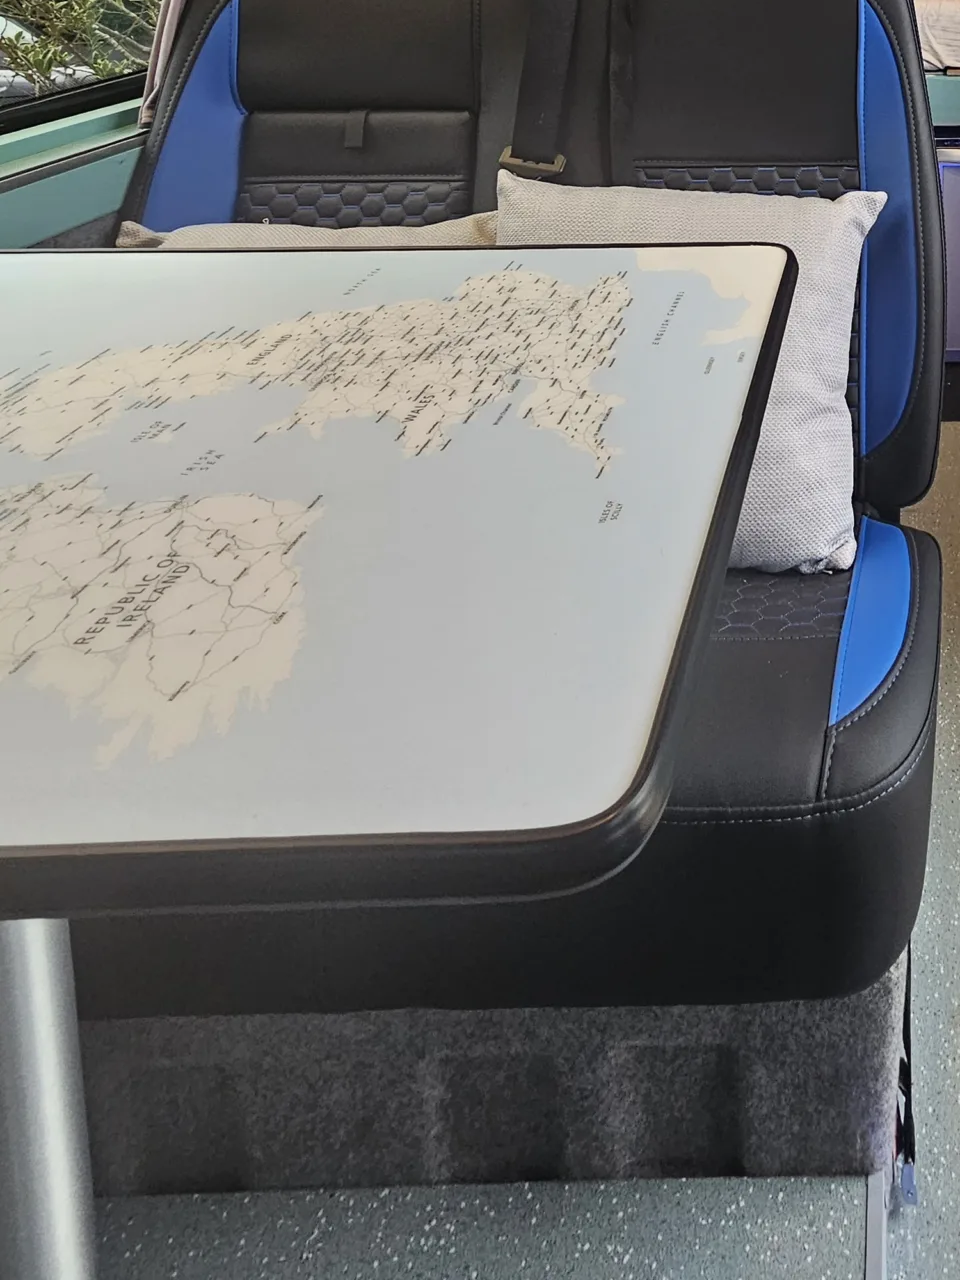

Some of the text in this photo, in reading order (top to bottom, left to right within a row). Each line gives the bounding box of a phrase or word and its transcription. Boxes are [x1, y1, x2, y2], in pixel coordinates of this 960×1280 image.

[245, 334, 293, 366] ENGLAND
[401, 394, 435, 424] WALES
[199, 453, 225, 471] SEA
[73, 573, 161, 645] REPUBLIC
[156, 551, 182, 569] OF
[116, 564, 191, 628] IRELAND
